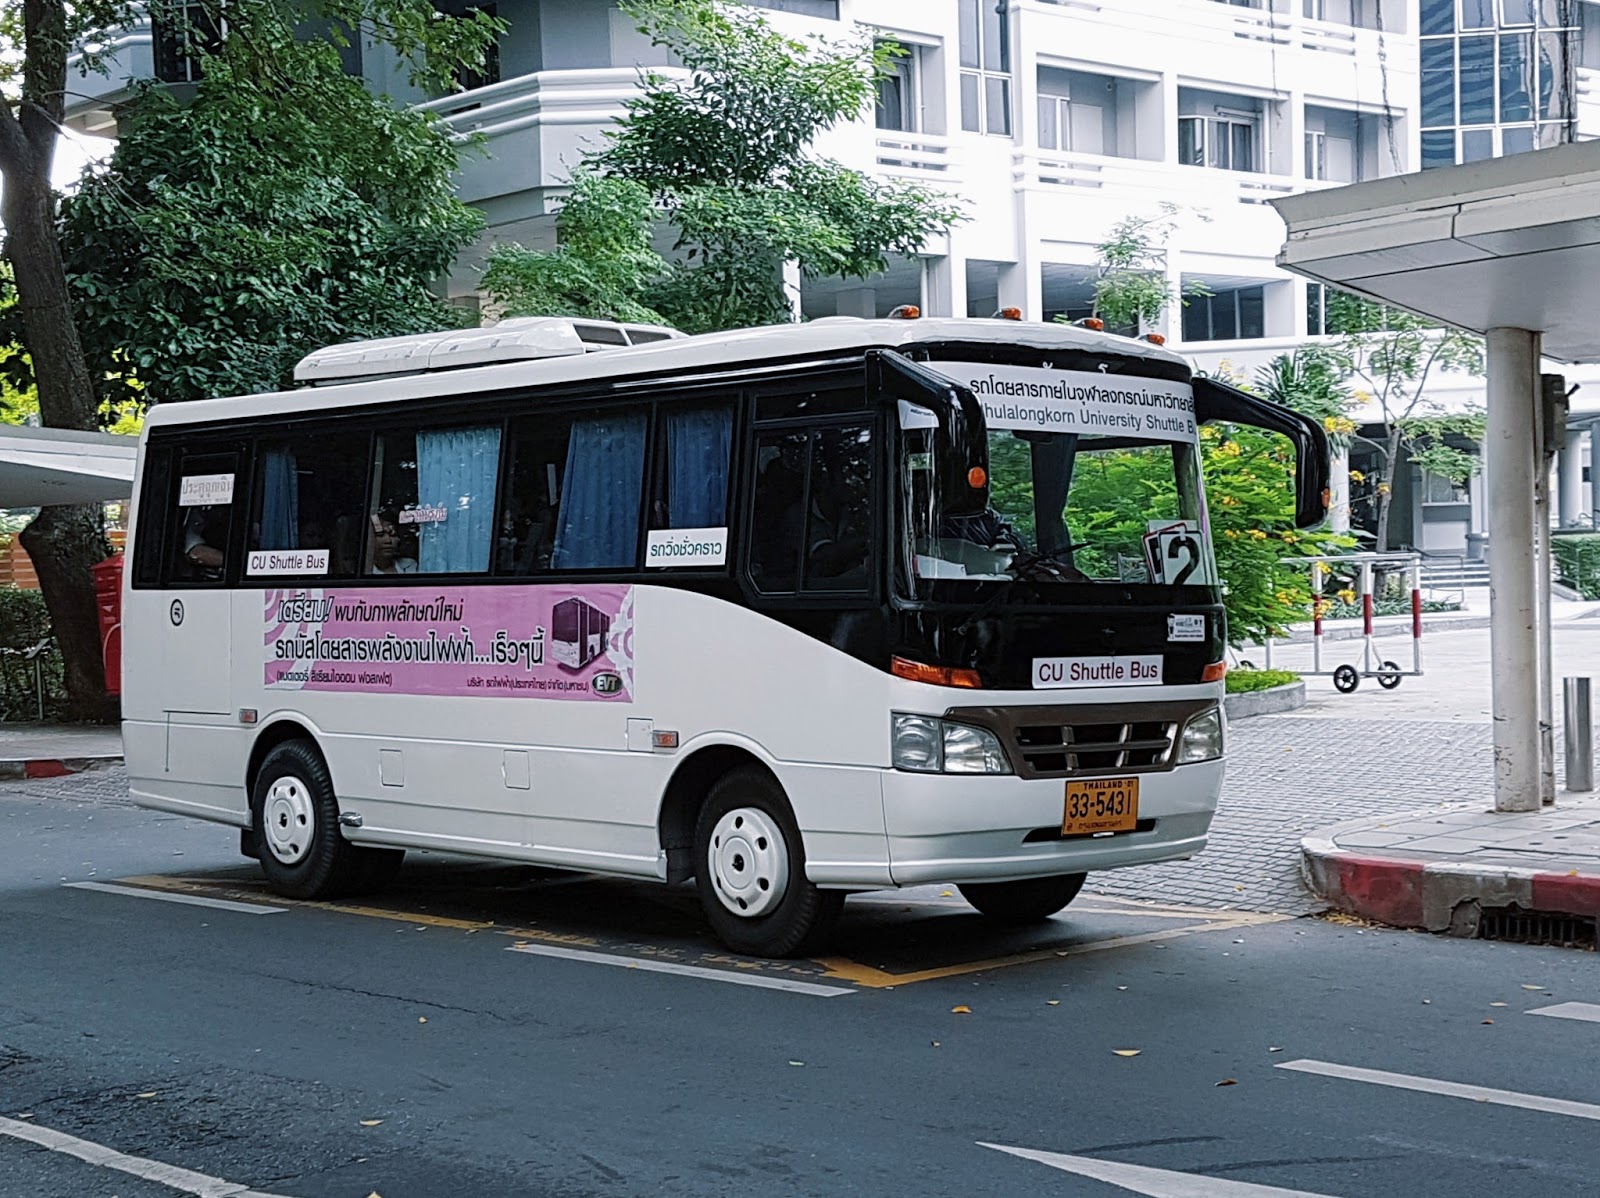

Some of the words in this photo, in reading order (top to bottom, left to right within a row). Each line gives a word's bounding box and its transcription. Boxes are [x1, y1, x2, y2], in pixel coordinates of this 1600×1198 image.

[970, 374, 1196, 413] รถโดยสารภายในจุฬาลงกรณ์มหาวิทยาลั
[983, 403, 1076, 425] hulalongkorn
[1079, 409, 1142, 432] University
[1146, 414, 1185, 432] Shuttle
[1187, 419, 1197, 436] B
[650, 536, 723, 557] รถวิ่งชั่วคราว
[251, 555, 267, 570] CU
[269, 554, 303, 569] Shuttle
[306, 554, 326, 569] Bus
[1168, 535, 1200, 585] 2
[277, 592, 335, 623] เตรียม!
[334, 596, 464, 622] พบกับภาพลักษณ์ใหม่
[596, 675, 618, 691] EVT
[1039, 663, 1063, 682] CU
[1070, 662, 1124, 681] Shuttle
[1130, 661, 1158, 678] Bus
[1083, 780, 1123, 790] THAILAND
[1069, 789, 1132, 819] 33-5431
